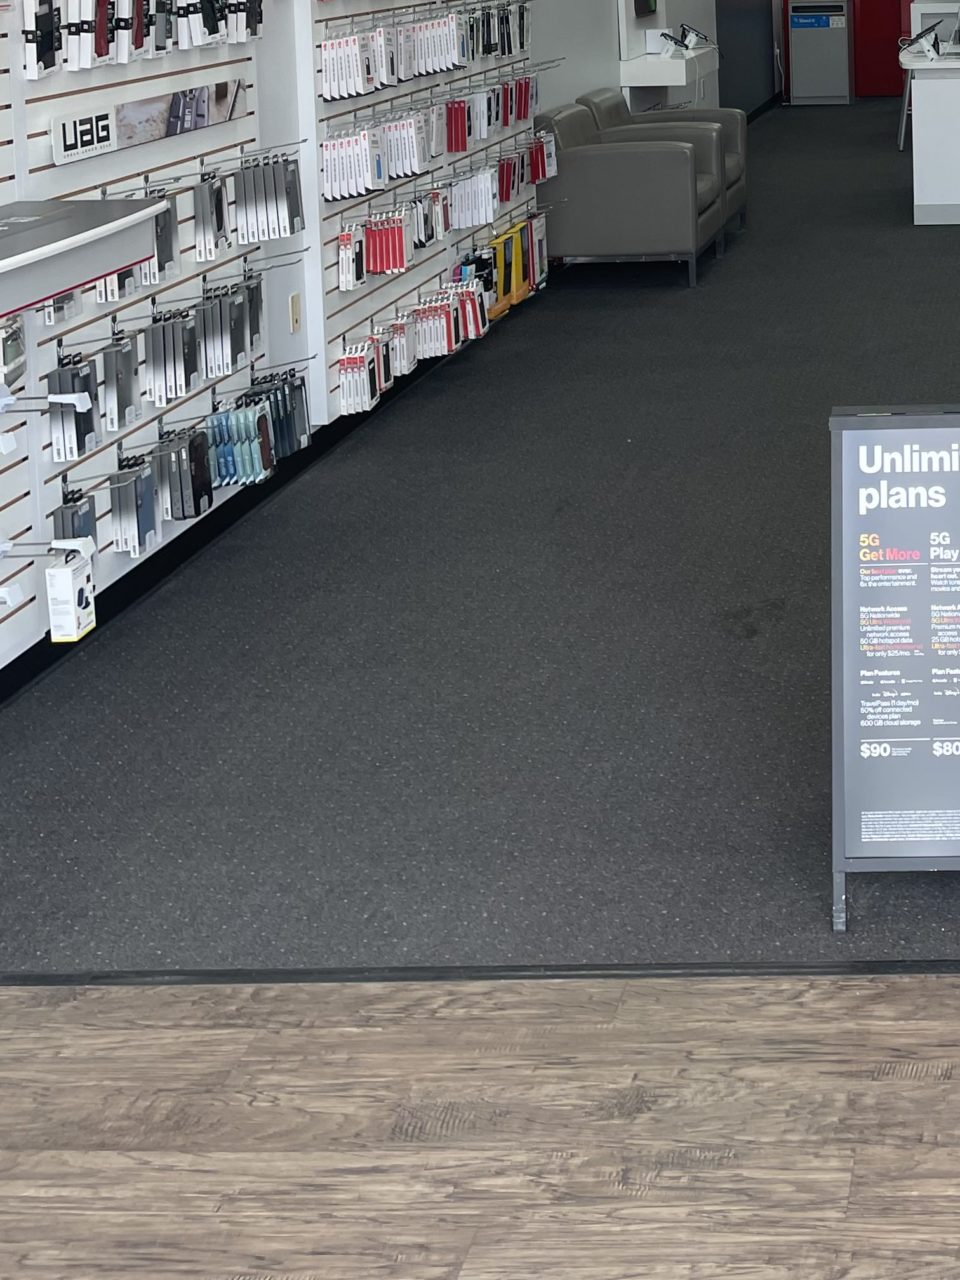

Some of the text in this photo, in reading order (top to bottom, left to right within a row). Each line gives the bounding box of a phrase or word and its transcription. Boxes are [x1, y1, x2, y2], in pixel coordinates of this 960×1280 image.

[61, 113, 111, 153] UAG
[858, 479, 947, 516] plans
[859, 533, 880, 547] 5G
[930, 531, 951, 545] 5G
[859, 547, 921, 561] Get More
[930, 546, 960, 562] Play
[860, 742, 891, 759] $90
